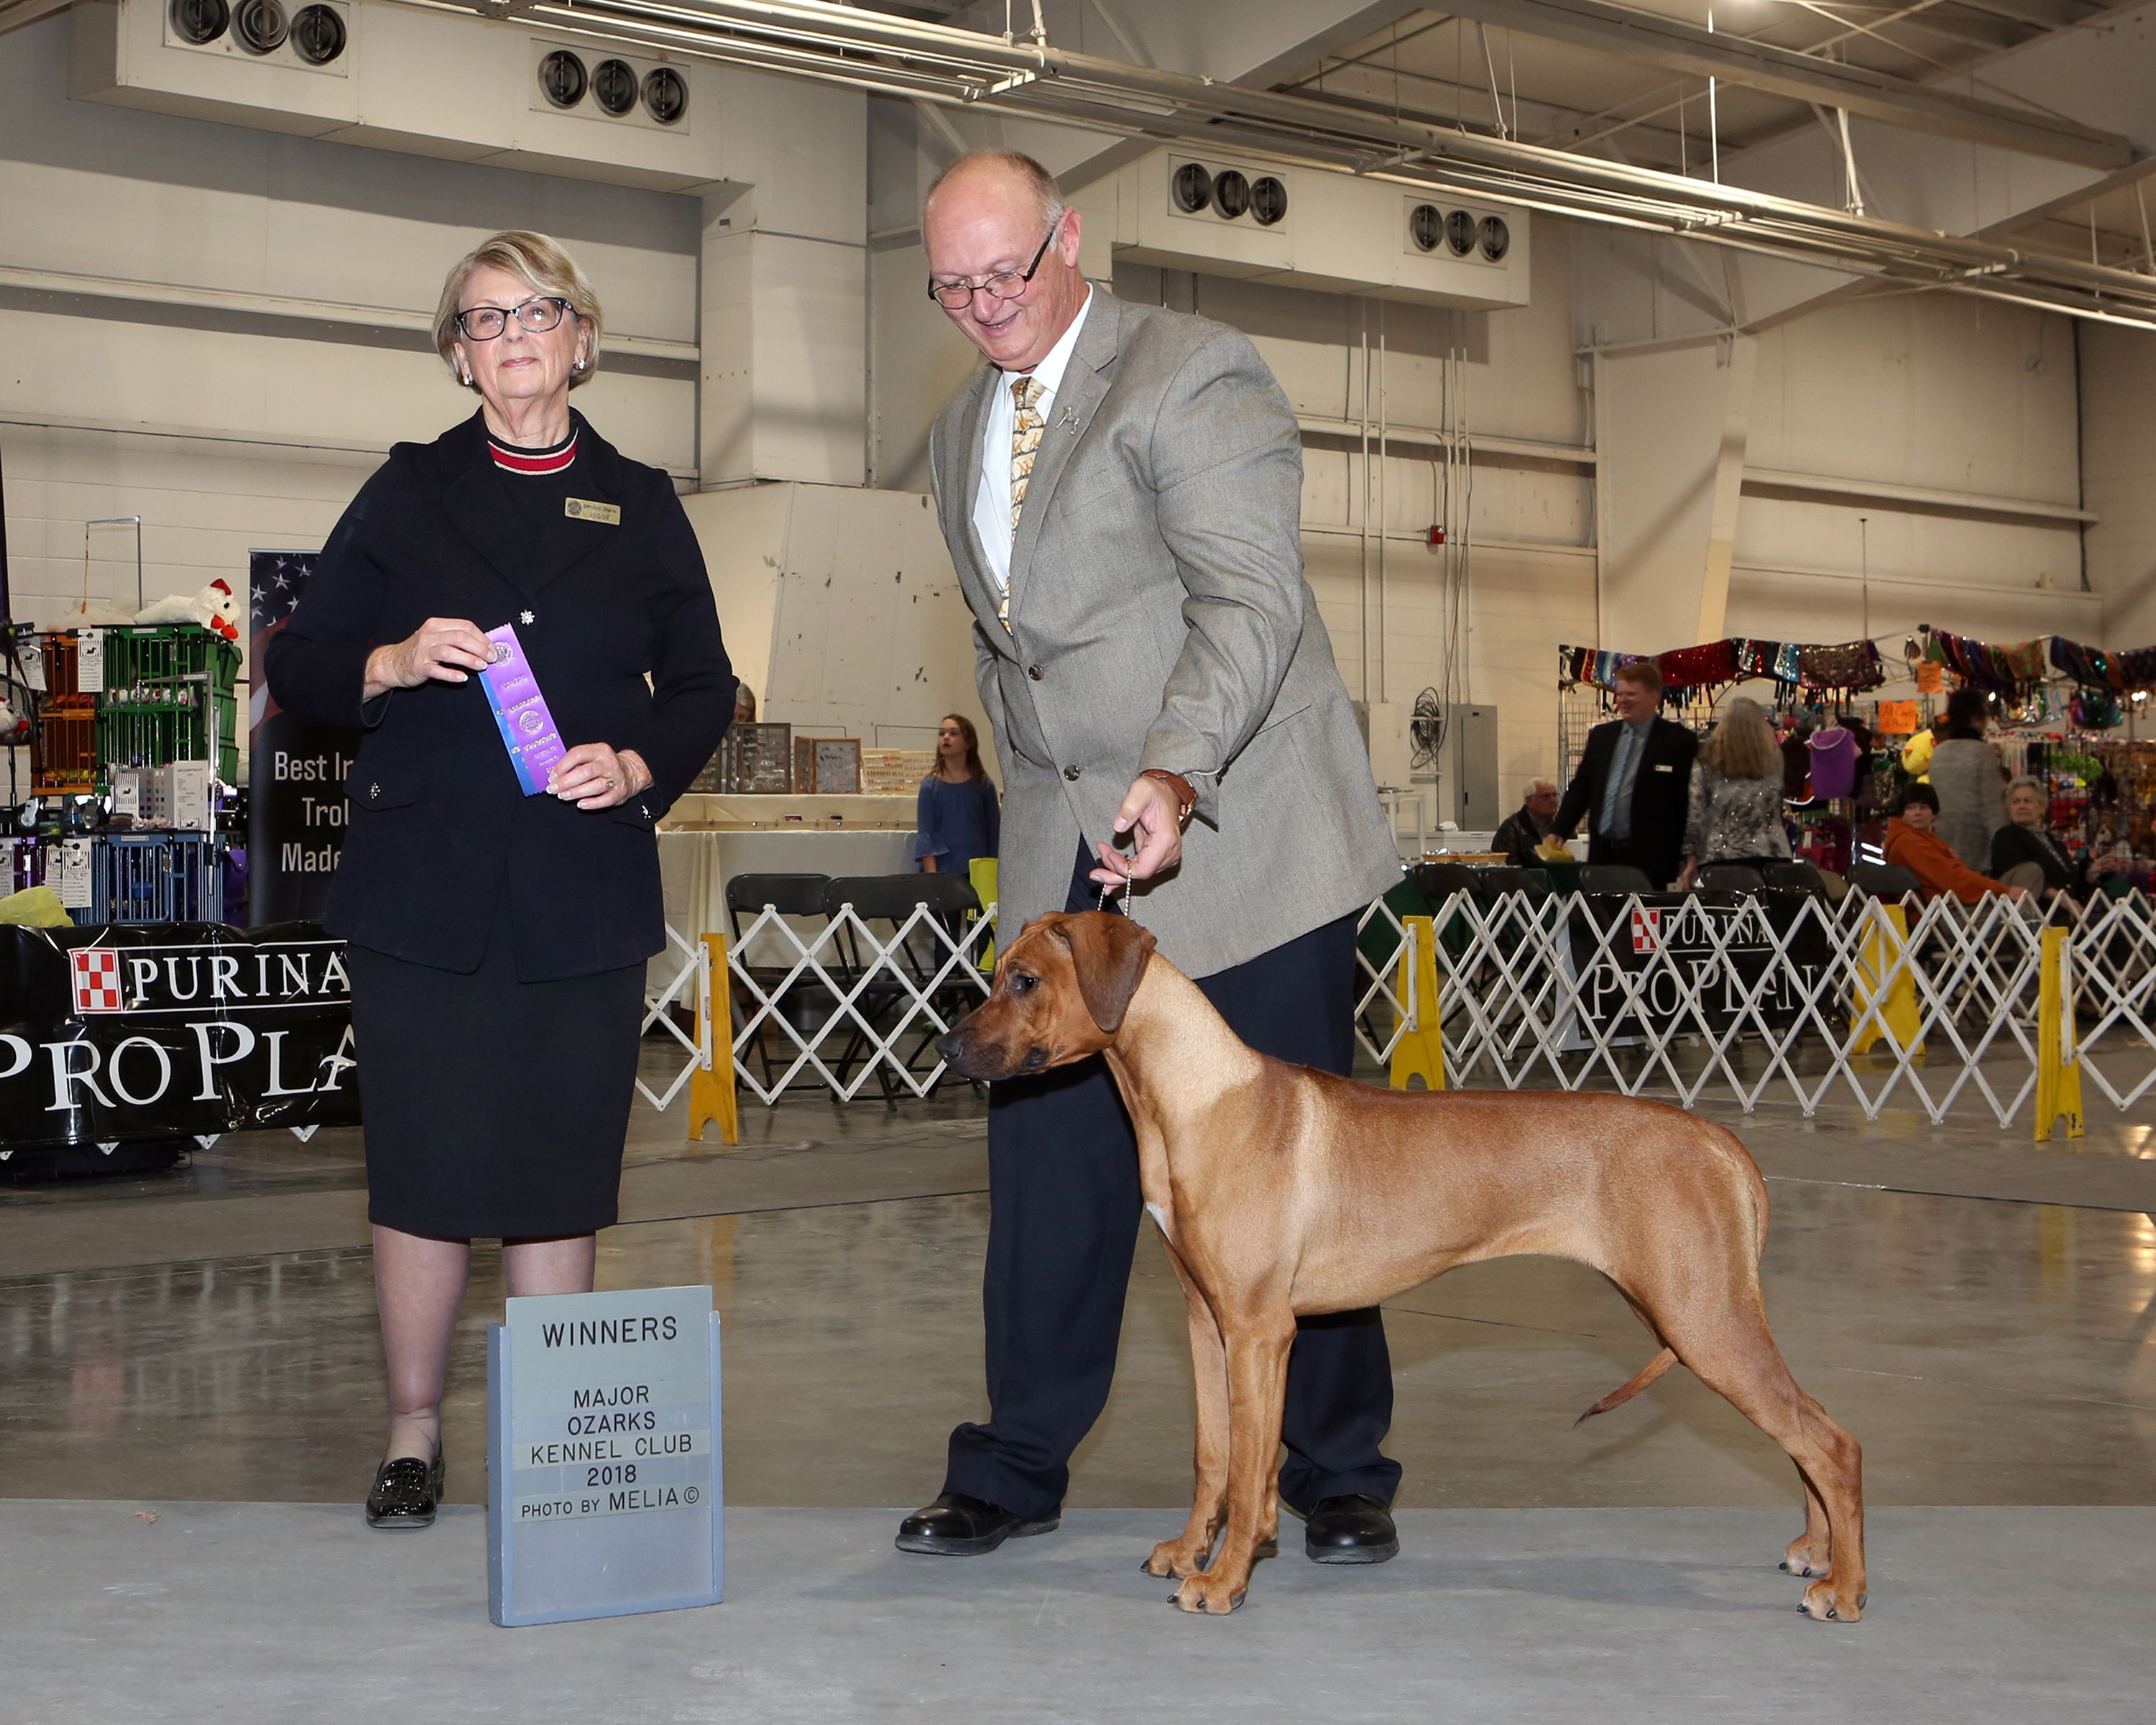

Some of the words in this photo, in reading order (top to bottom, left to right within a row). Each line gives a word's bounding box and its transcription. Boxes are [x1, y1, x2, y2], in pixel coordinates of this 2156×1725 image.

[275, 751, 328, 781] Best
[302, 797, 349, 827] Trol
[129, 950, 351, 1003] PURINA
[542, 1315, 678, 1348] WINNERS
[573, 1384, 650, 1409] MAJOR
[568, 1411, 656, 1436] OZARKS
[531, 1440, 622, 1465] KENNEL
[635, 1434, 693, 1456] CLUB
[586, 1464, 637, 1487] 2018
[522, 1501, 573, 1518] PHOTO
[581, 1499, 600, 1513] BY
